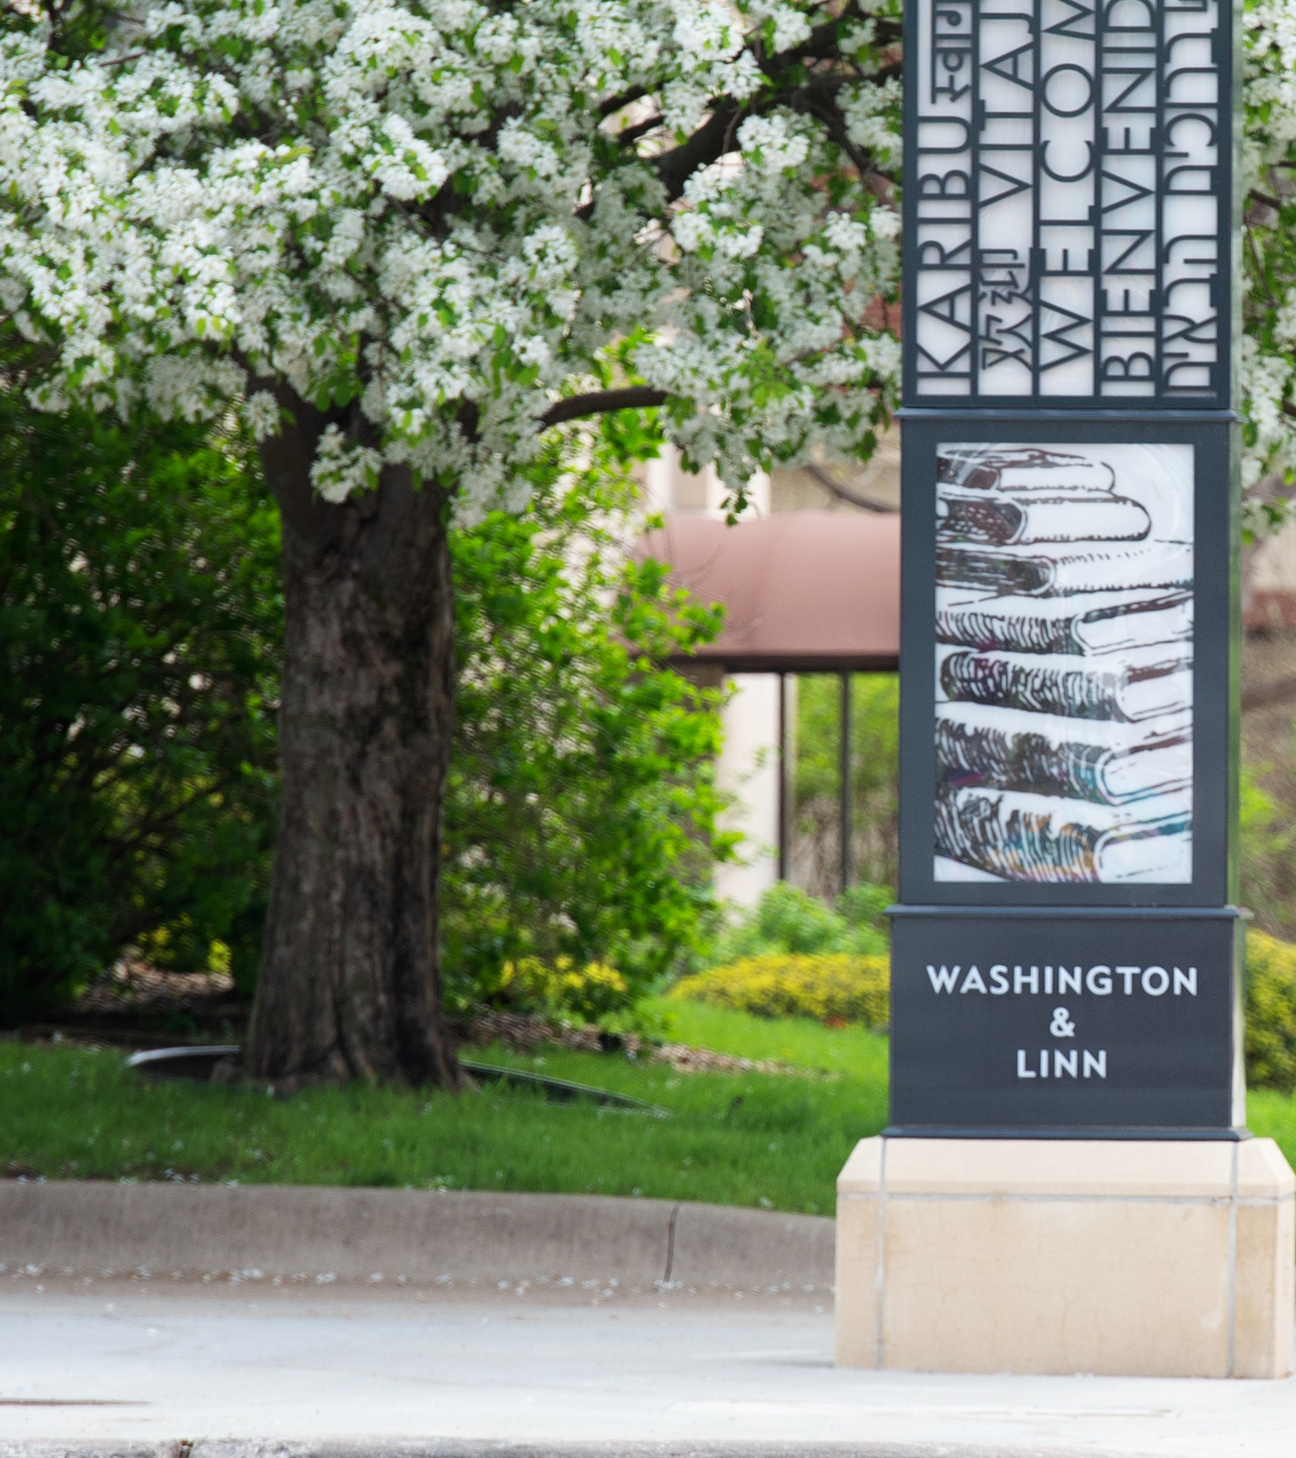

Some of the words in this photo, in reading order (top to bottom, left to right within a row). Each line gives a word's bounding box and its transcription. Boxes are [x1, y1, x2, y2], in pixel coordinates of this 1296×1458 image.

[977, 12, 1034, 209] VITAJ
[914, 115, 975, 378] KARIBU
[978, 247, 1034, 371] 欢迎
[926, 965, 1198, 996] WASHINGTON
[1050, 1007, 1076, 1037] &
[1017, 1050, 1107, 1079] LINN
